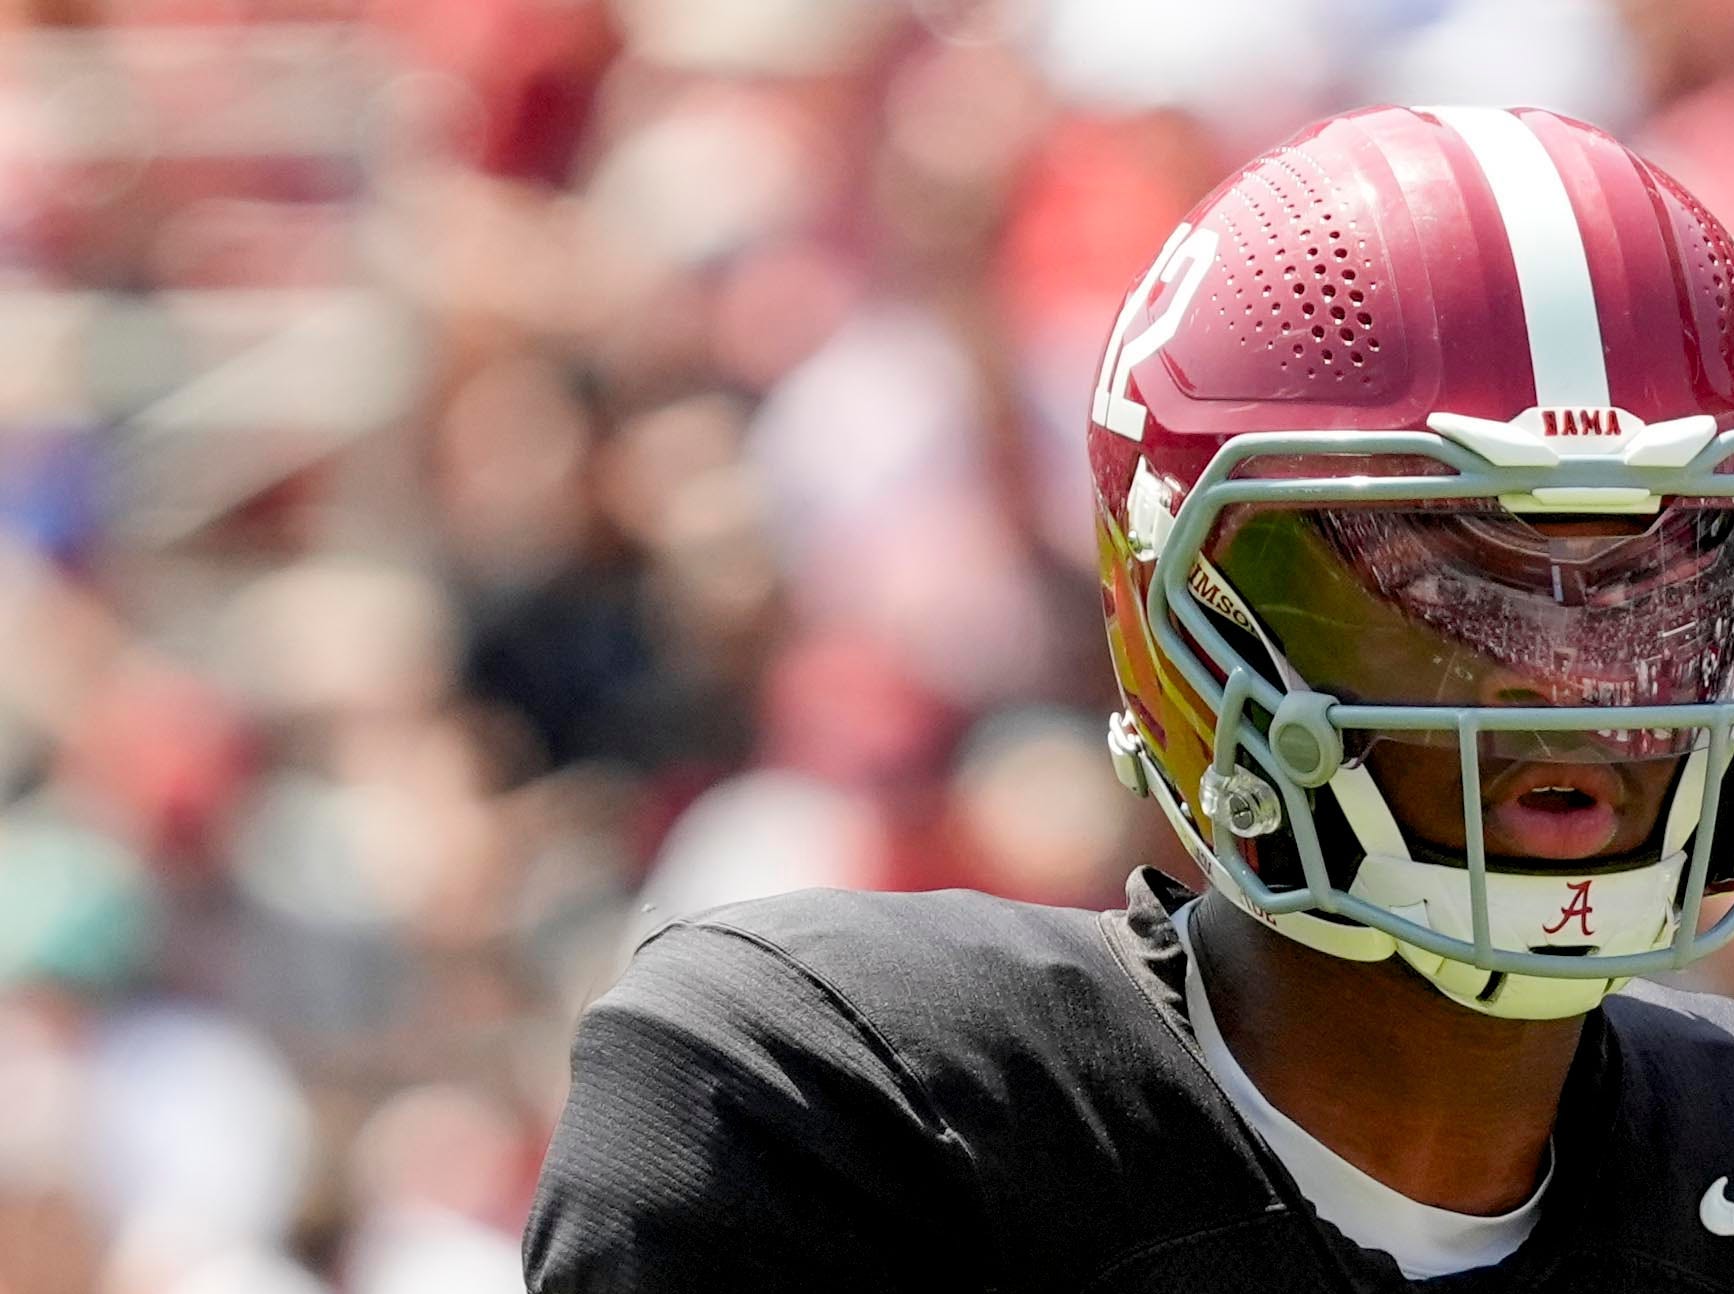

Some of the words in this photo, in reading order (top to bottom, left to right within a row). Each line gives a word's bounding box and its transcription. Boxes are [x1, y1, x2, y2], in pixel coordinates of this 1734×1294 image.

[1091, 221, 1219, 442] 12
[1542, 409, 1621, 436] BAMA
[1542, 880, 1595, 935] A
